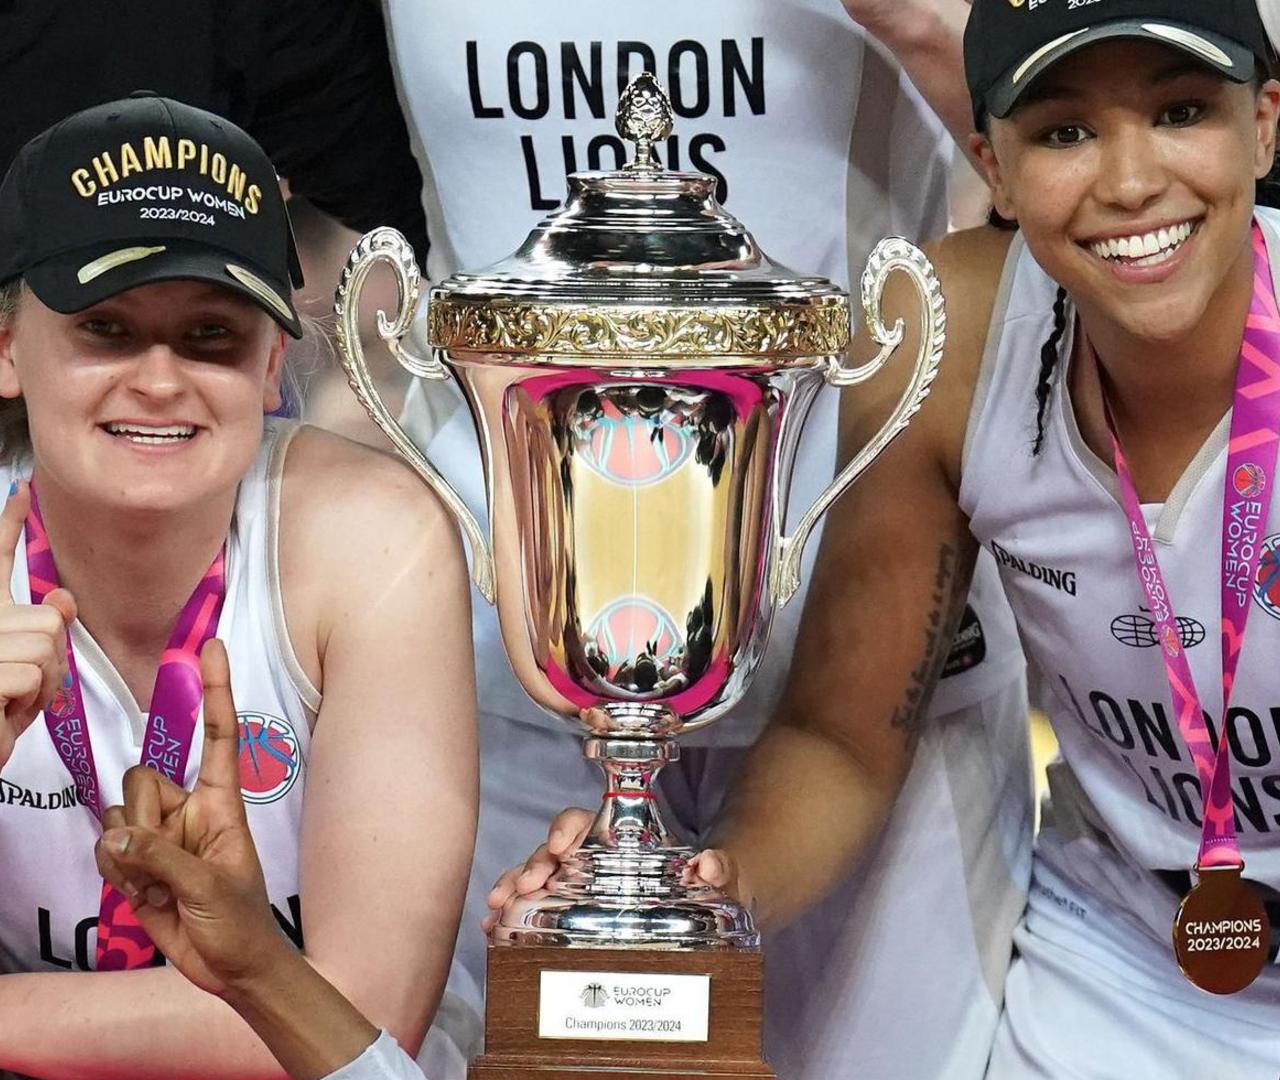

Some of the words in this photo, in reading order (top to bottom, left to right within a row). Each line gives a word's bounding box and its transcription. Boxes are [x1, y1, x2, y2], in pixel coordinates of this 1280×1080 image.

[71, 136, 262, 215] CHAMPIONS
[97, 186, 183, 206] EUROCUP
[187, 188, 246, 220] WOMEN
[139, 207, 215, 226] 2023/2024
[1225, 501, 1245, 588] WOMEN
[1236, 502, 1261, 607] EUROCUP
[991, 540, 1077, 596] SPALDING
[1185, 919, 1262, 936] CHAMPIONS
[1187, 936, 1260, 951] 2023/2024
[613, 986, 671, 998] EUROCUP
[614, 997, 662, 1007] WOMEN
[565, 1017, 627, 1032] Champions
[629, 1019, 682, 1032] 2023/2024
